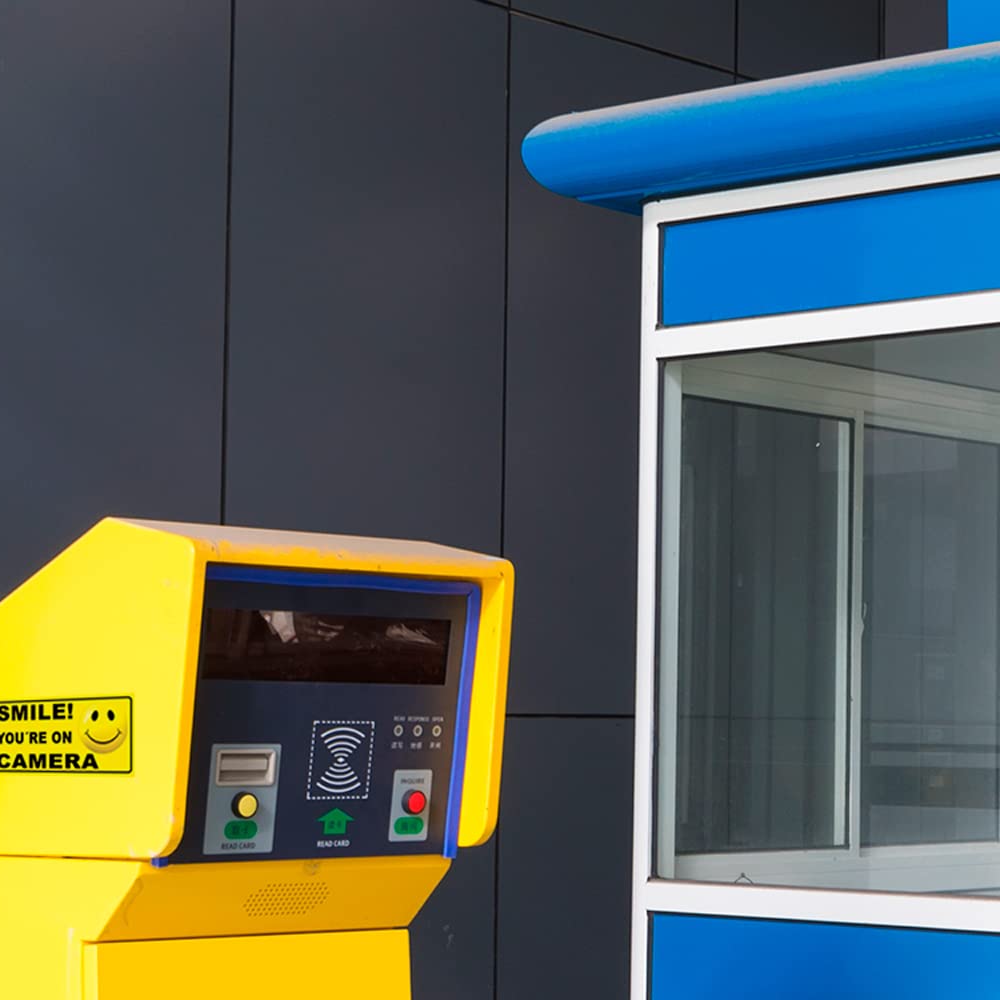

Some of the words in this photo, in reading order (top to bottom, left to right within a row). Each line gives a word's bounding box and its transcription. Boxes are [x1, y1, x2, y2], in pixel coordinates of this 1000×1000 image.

[51, 731, 73, 744] ON
[220, 842, 238, 850] READ
[239, 841, 257, 849] CARD
[316, 839, 333, 848] READ
[333, 839, 350, 848] CARD
